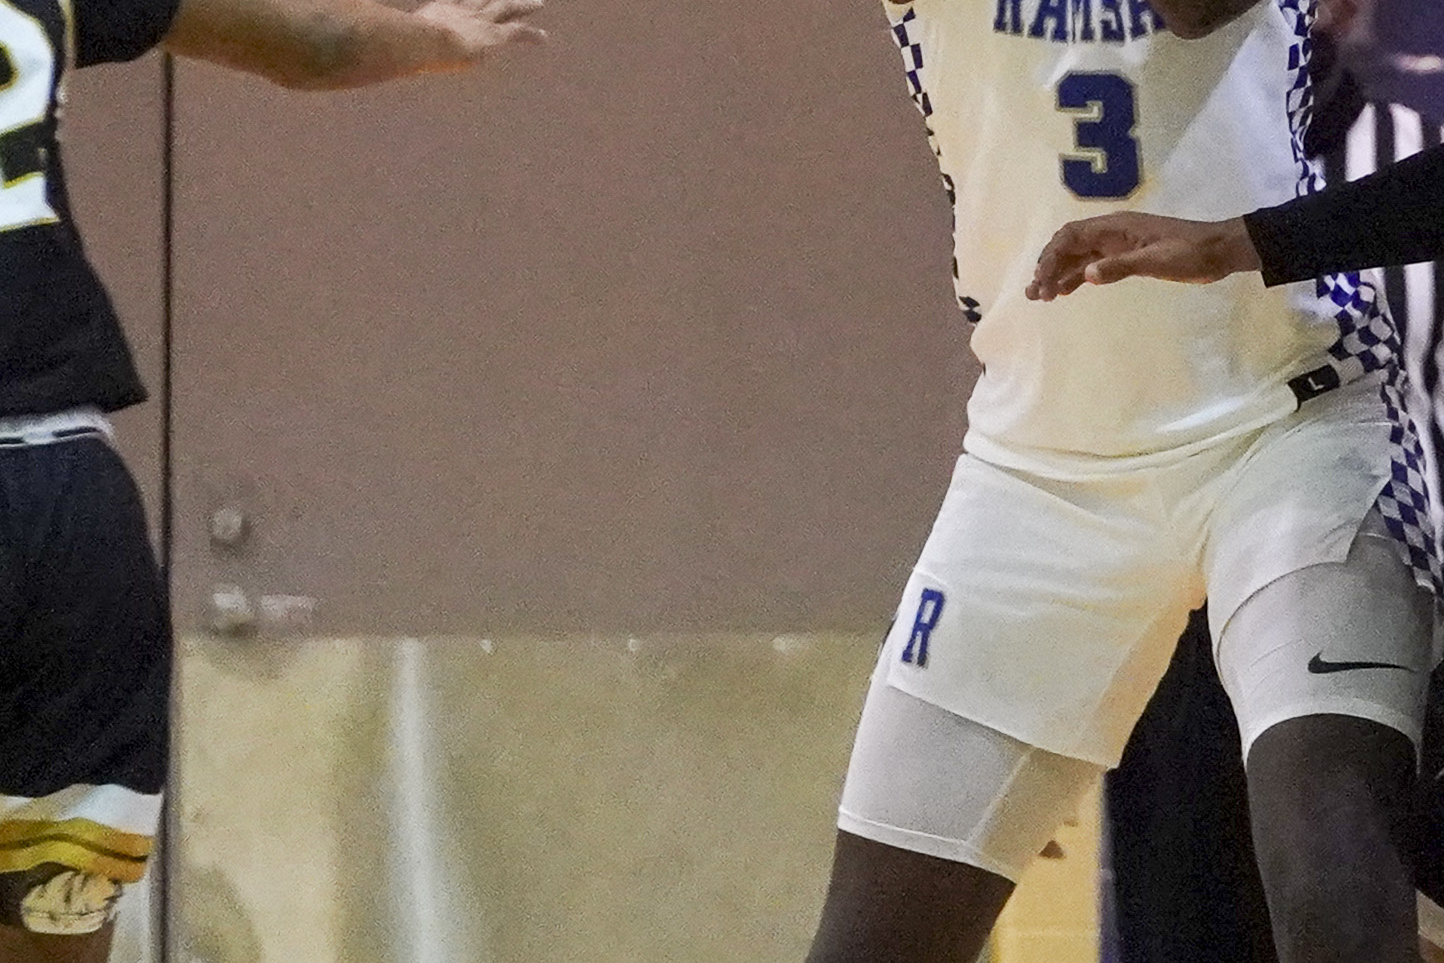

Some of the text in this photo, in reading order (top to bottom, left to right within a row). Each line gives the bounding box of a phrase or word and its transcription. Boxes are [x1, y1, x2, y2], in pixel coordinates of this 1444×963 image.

[1057, 70, 1142, 201] 3
[1308, 377, 1325, 391] L
[902, 587, 945, 669] R
